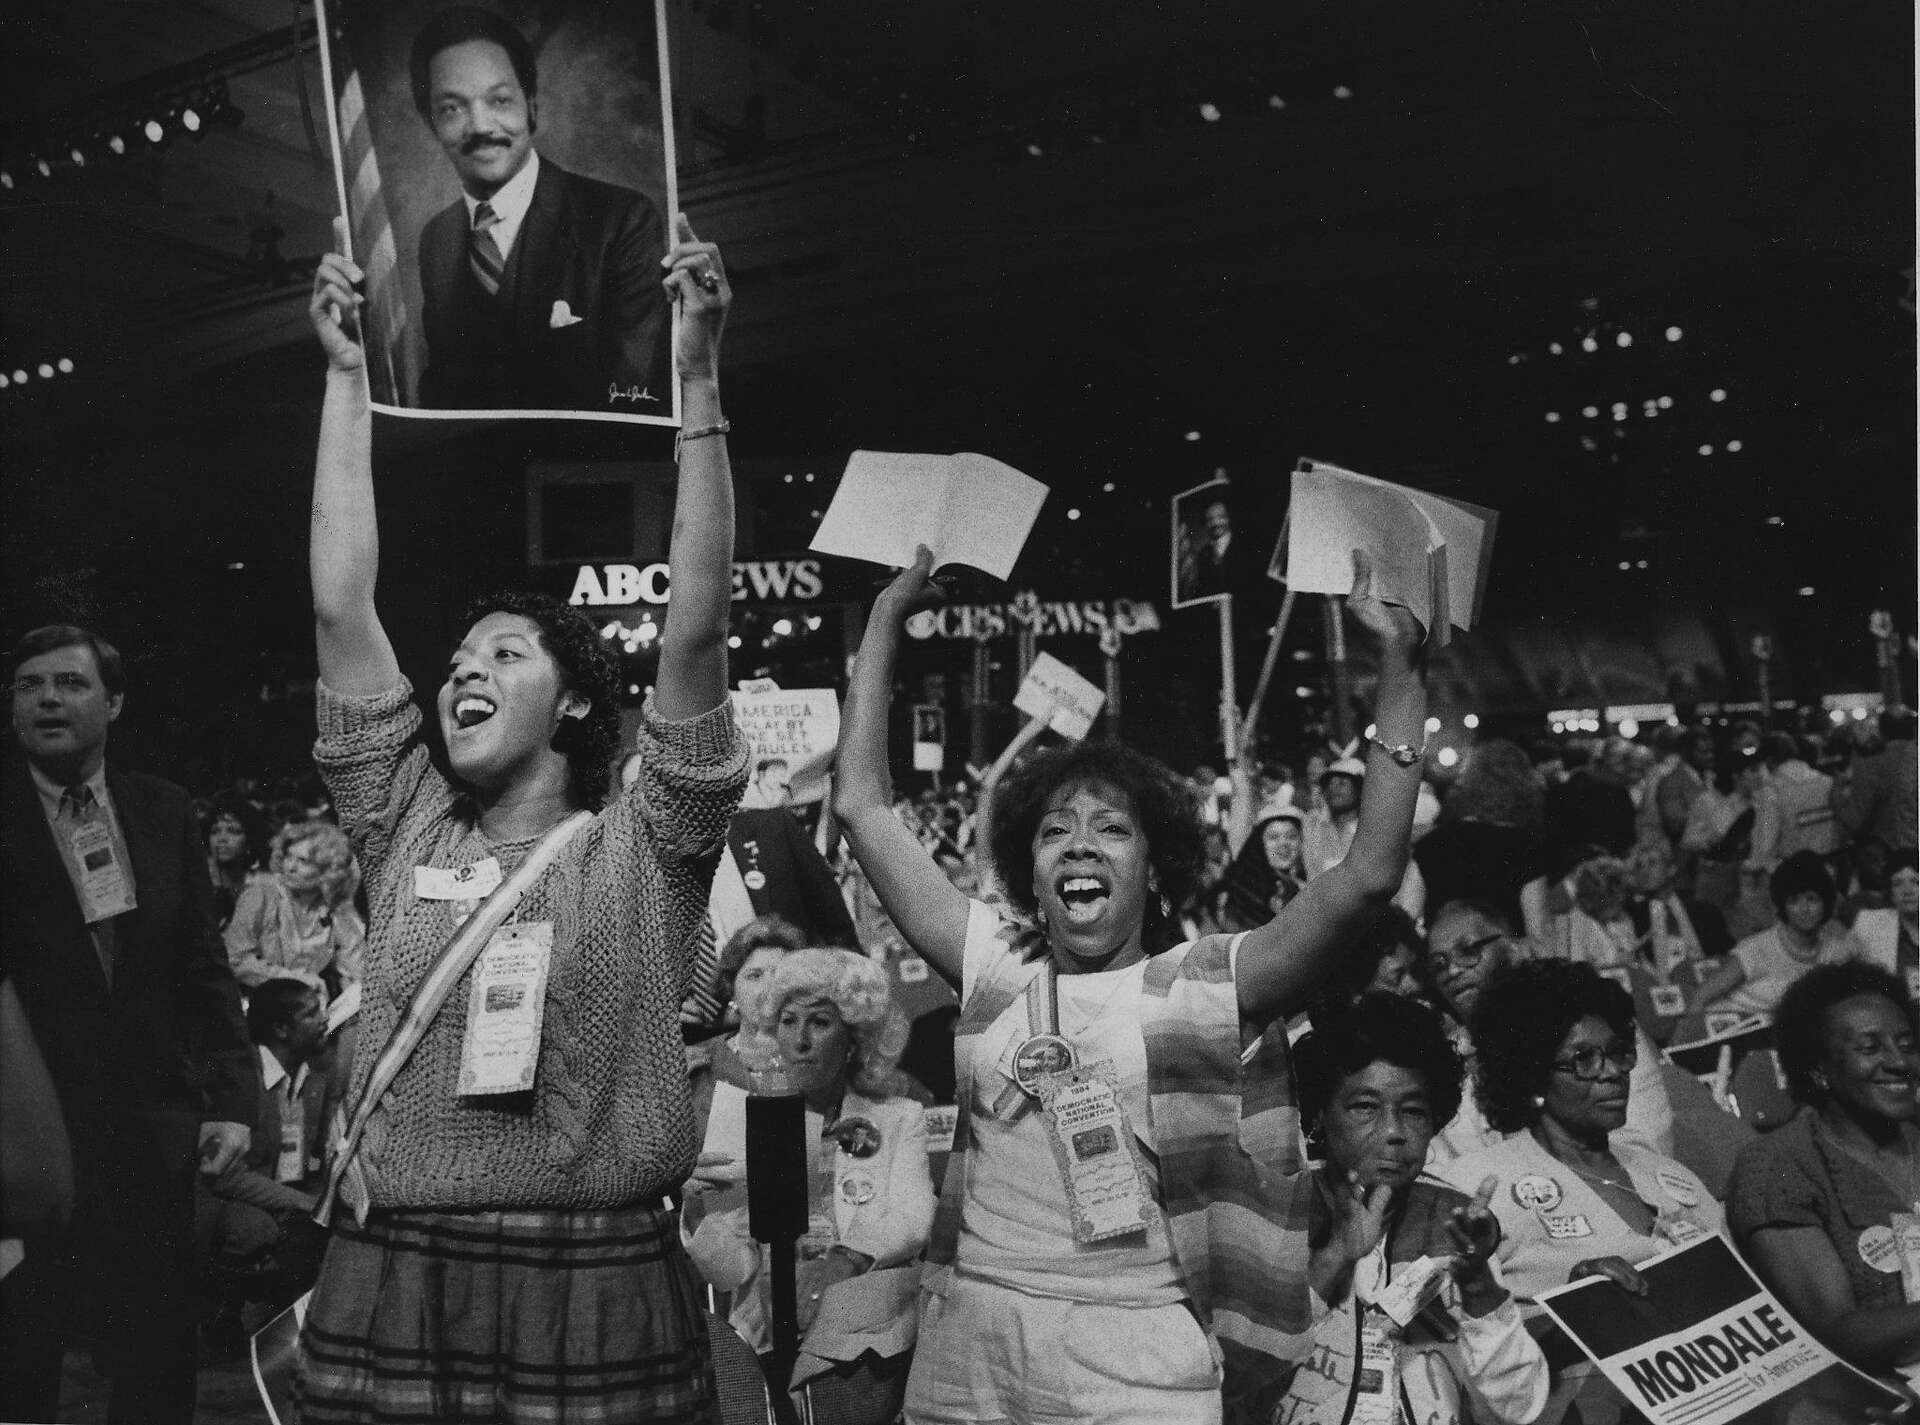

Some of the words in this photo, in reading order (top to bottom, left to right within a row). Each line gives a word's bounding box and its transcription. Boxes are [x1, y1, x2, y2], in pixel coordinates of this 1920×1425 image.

[568, 562, 671, 606] ABC
[732, 558, 824, 602] EWS
[932, 605, 1006, 639] CBS
[1056, 1091, 1111, 1113] DEMOCRATIC
[1065, 1101, 1105, 1117] NATIONAL
[1061, 1107, 1115, 1126] CONVENTION
[1622, 1303, 1797, 1408] MONDALE
